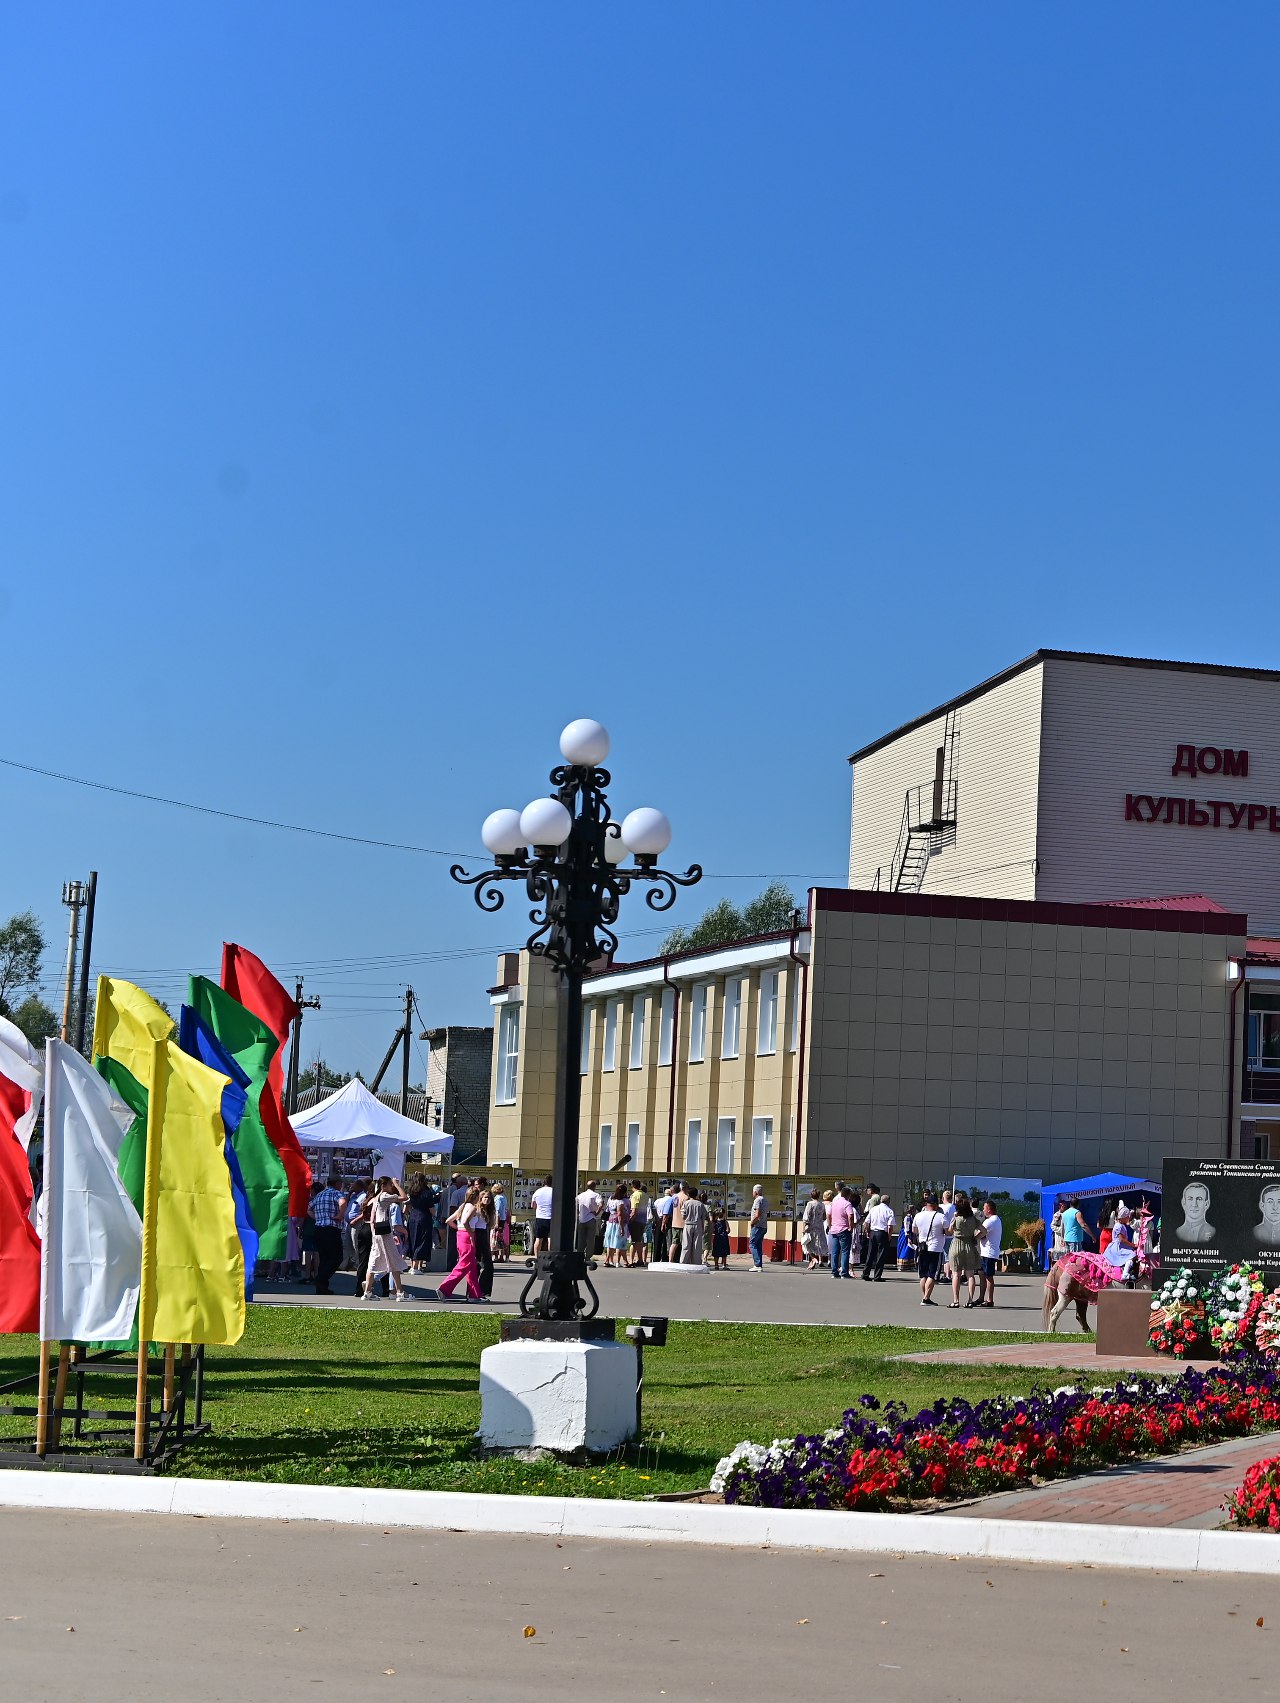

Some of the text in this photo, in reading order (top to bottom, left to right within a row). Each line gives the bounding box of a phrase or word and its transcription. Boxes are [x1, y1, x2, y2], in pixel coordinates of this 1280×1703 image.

[1171, 744, 1249, 778] ДОМ
[1172, 1248, 1220, 1256] ВЫЧУЖАНИН
[1192, 1256, 1228, 1264] Алексеевич
